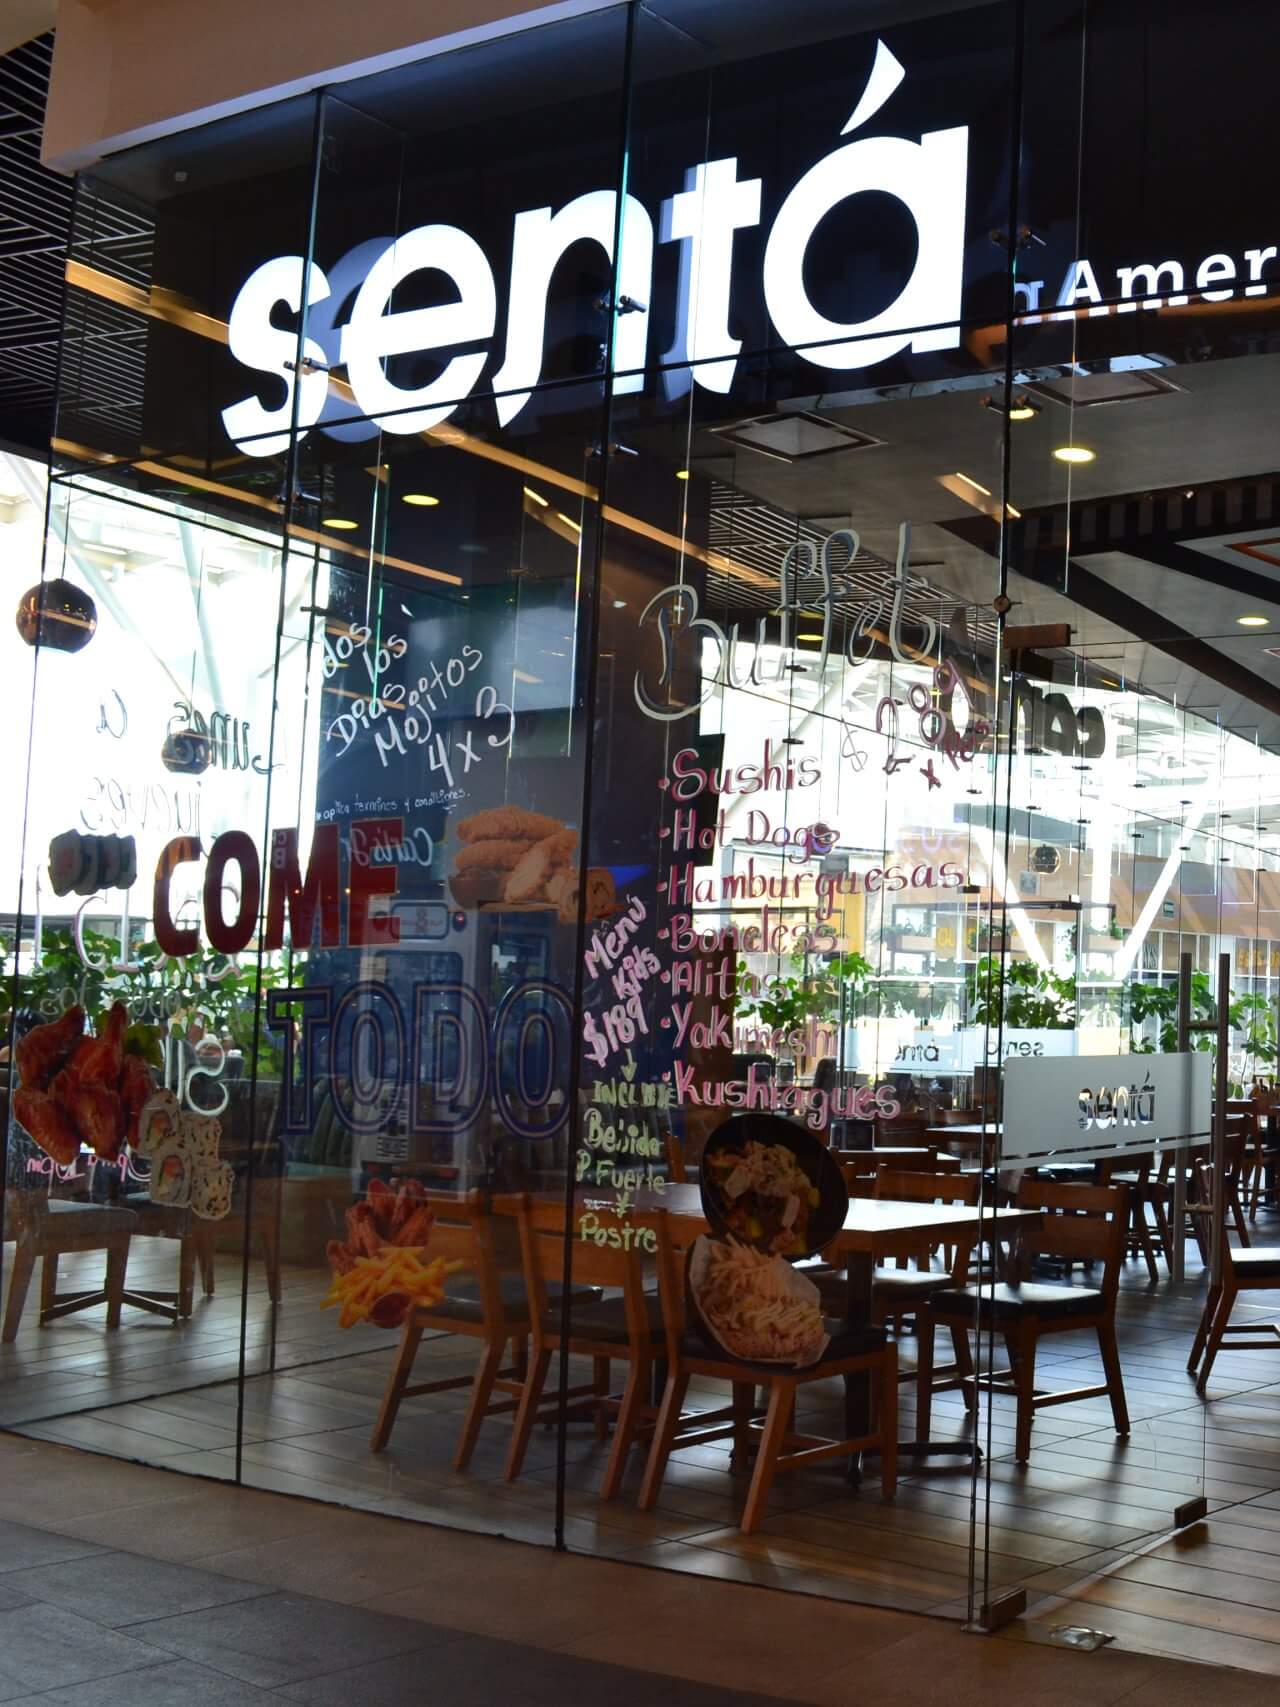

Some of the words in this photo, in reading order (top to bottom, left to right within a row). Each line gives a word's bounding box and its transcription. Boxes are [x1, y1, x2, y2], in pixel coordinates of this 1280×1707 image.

[221, 40, 970, 459] sentá
[362, 633, 408, 685] los
[373, 643, 484, 768] Mojitos
[671, 737, 823, 803] Sushis
[672, 808, 731, 852] Hot
[745, 808, 842, 865] Dogs
[152, 817, 404, 958] COME
[666, 855, 967, 922] Hamburguesas
[668, 902, 841, 954] Boneless
[671, 957, 788, 1003] Alitas
[267, 980, 576, 1142] TODO
[583, 993, 650, 1069] $189
[671, 1000, 840, 1058] Yakimeshi
[1076, 1066, 1156, 1137] sentá
[578, 1212, 660, 1255] Postre
